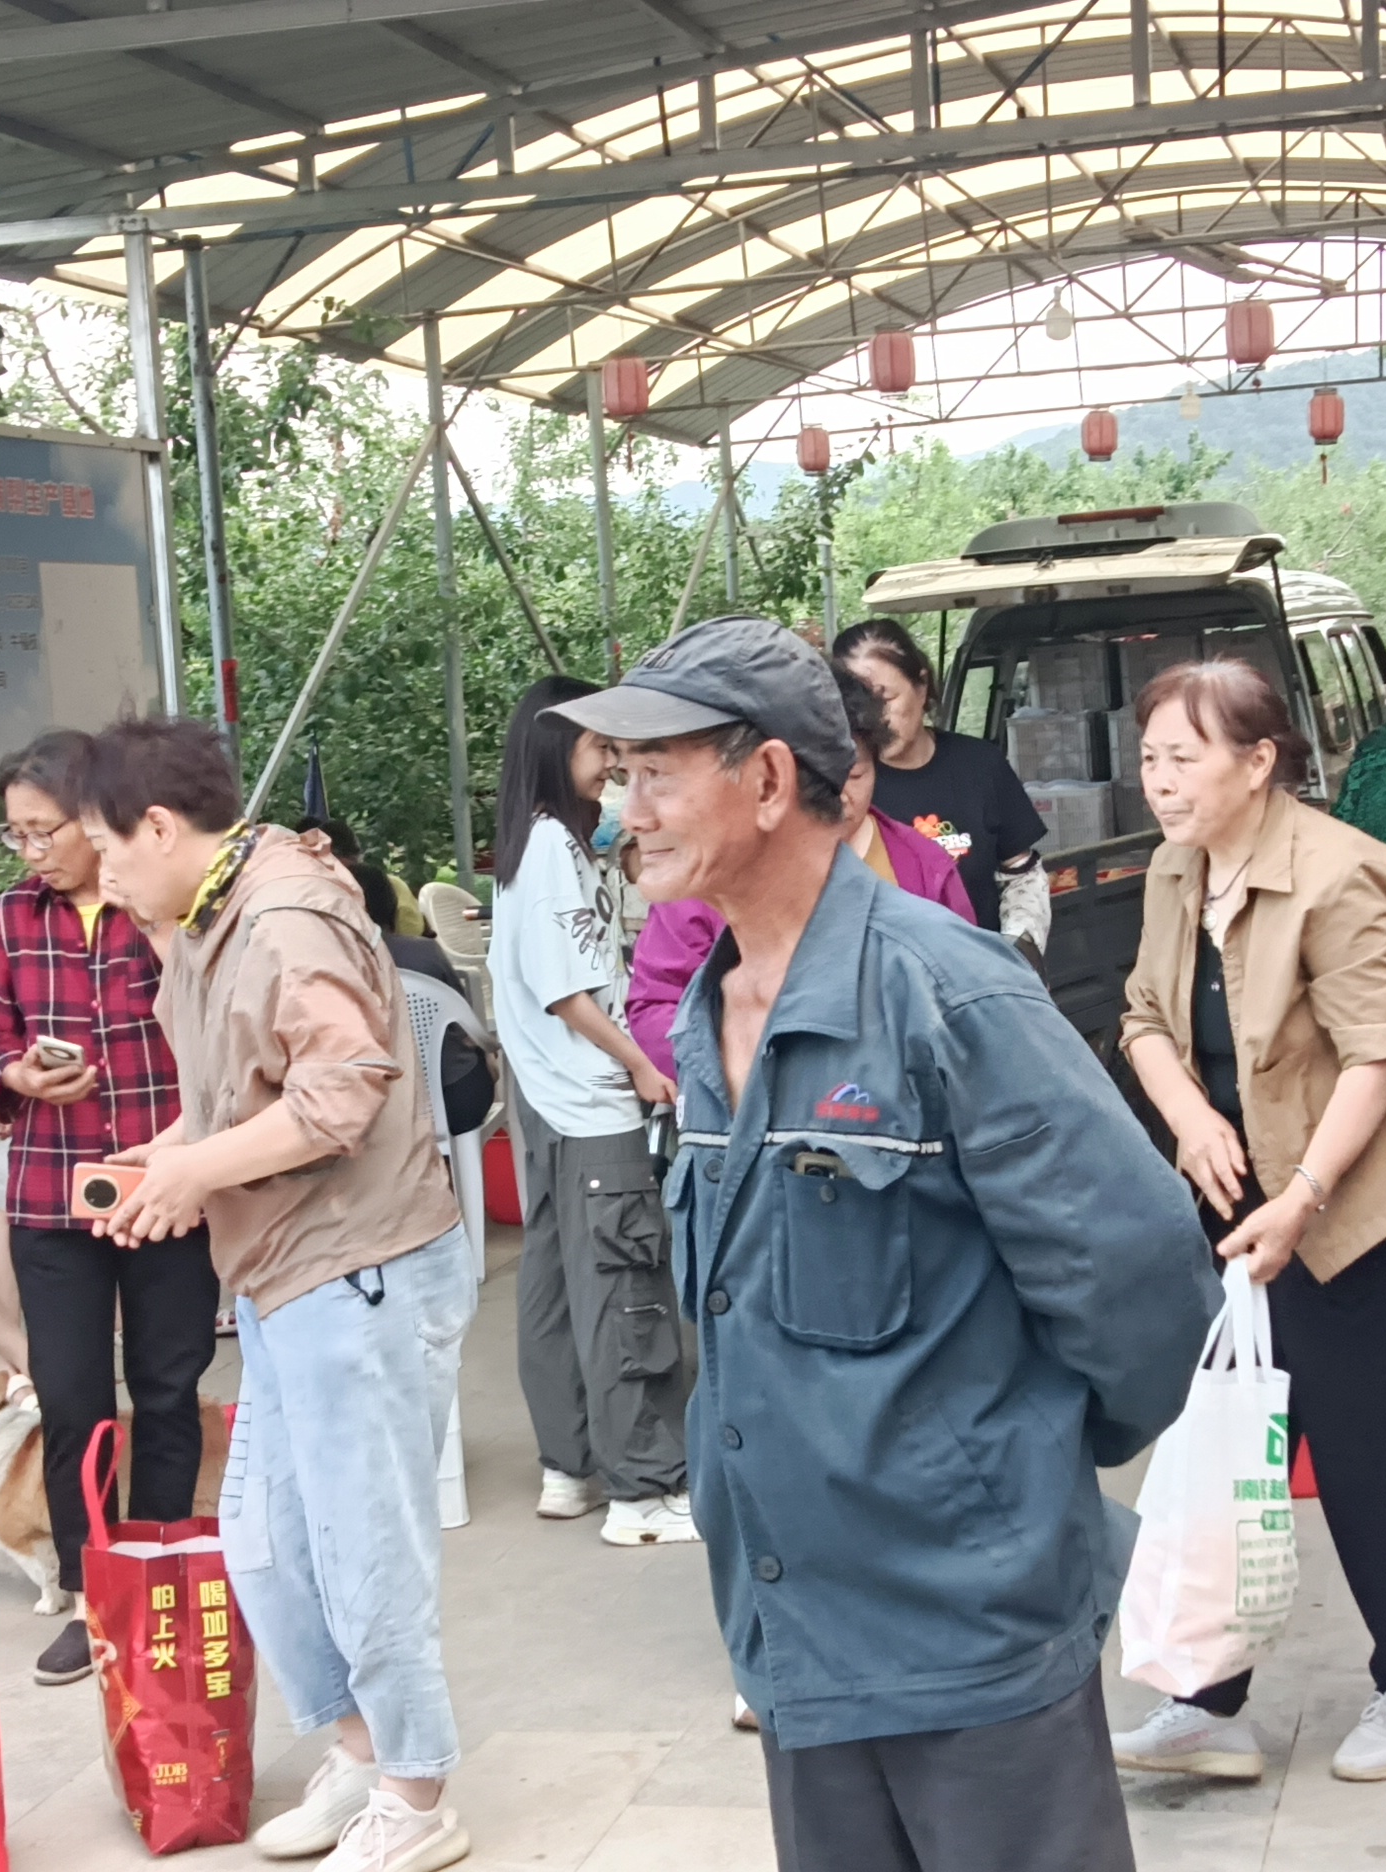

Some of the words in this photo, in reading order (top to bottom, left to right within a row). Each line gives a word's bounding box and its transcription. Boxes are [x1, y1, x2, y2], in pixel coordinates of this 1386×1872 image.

[150, 1584, 178, 1672] 怕上火
[199, 1579, 233, 1700] 喝加多宝
[152, 1762, 188, 1778] JDB
